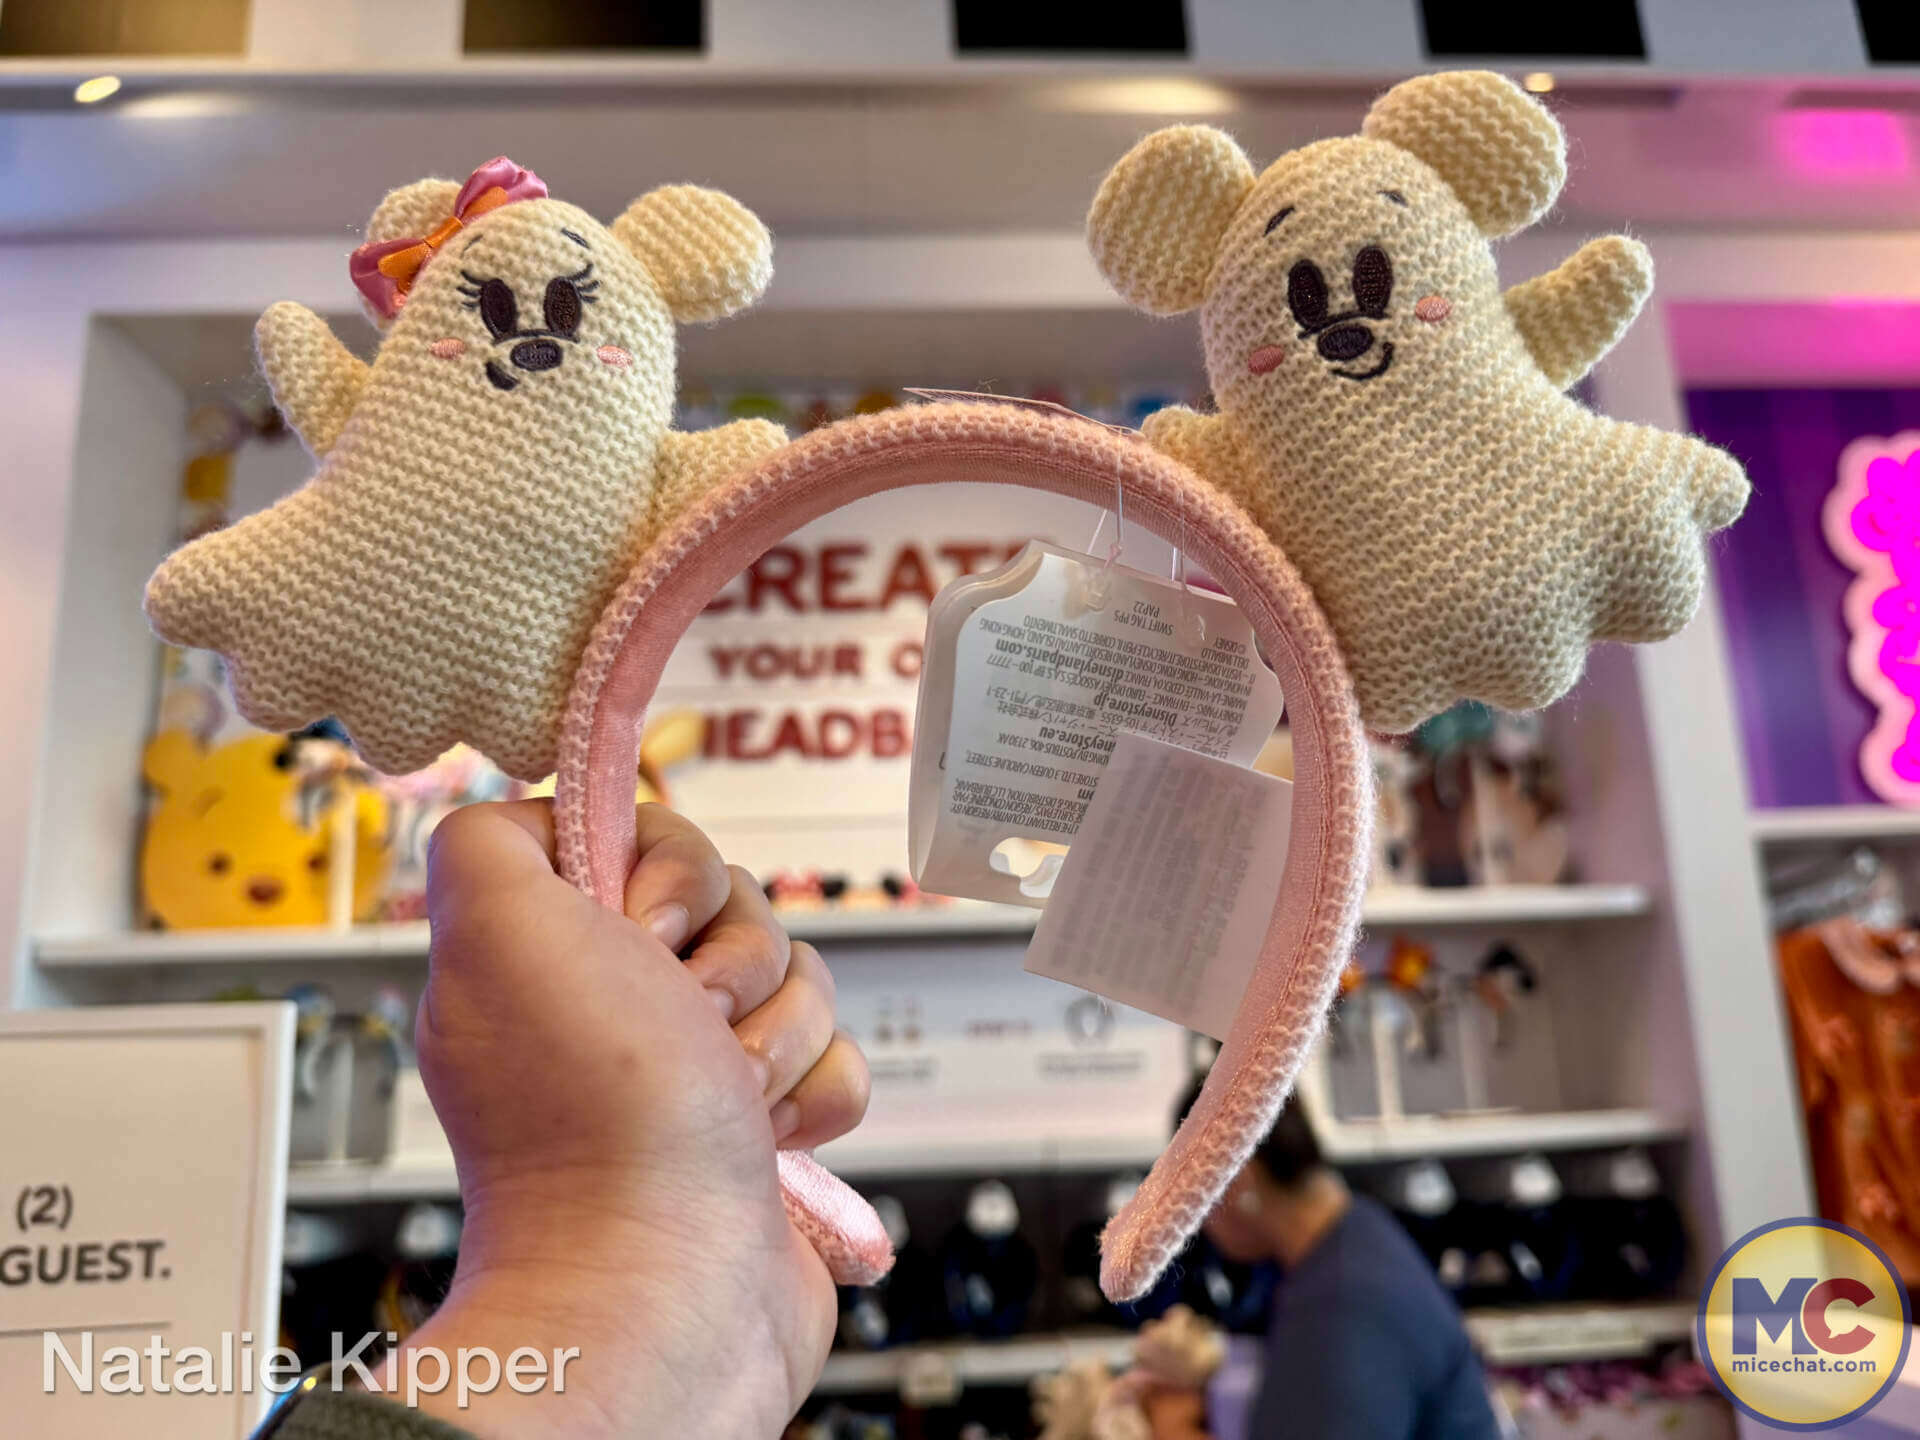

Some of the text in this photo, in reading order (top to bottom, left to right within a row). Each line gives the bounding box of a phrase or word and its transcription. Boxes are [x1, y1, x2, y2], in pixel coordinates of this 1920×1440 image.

[700, 540, 1043, 615] REAT
[1132, 600, 1160, 618] PAP22
[978, 617, 1002, 634] KONG
[1129, 613, 1147, 629] TAG
[1148, 618, 1173, 636] SWIFT
[1000, 623, 1025, 640] HONG
[711, 646, 861, 677] YOUR
[993, 635, 1125, 684] disneylandparis.com
[1018, 660, 1033, 674] 100
[1111, 651, 1157, 673] DISNEYLAND
[1123, 670, 1152, 687] FRANCE
[1099, 680, 1126, 696] DISNEY
[1124, 686, 1145, 701] EURO
[1091, 691, 1178, 726] Disneystore.jp
[1151, 692, 1180, 709] FRANCE
[1194, 703, 1219, 719] PARKS
[1217, 708, 1242, 724] DISNEY
[1007, 735, 1029, 748] 2130
[1043, 742, 1079, 758] POSTBUS
[989, 756, 1031, 773] CAROLINE
[1023, 815, 1060, 830] RELEVANT
[1058, 821, 1075, 833] THE
[16, 1185, 73, 1231] (2)
[0, 1240, 171, 1285] GUEST.
